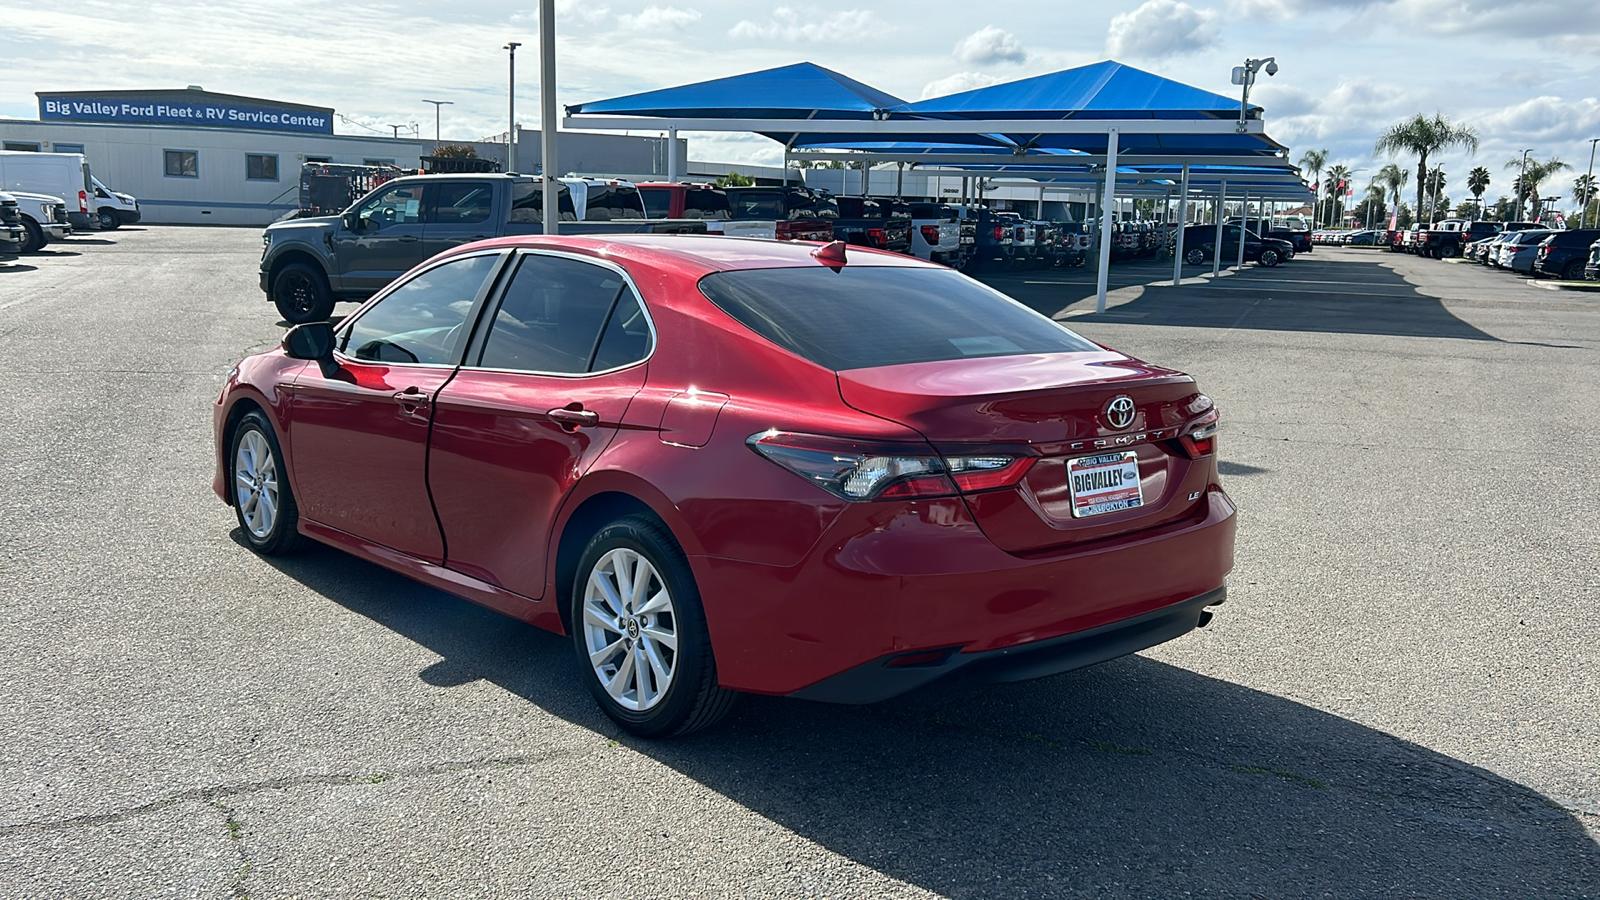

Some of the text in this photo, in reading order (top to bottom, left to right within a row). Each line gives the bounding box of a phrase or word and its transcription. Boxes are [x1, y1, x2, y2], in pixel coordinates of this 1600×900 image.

[45, 101, 325, 127] Big Valley Ford Fleet & RV Service Center
[1070, 431, 1163, 449] CAMRY
[1085, 454, 1121, 466] BIG VALLEY
[1073, 468, 1123, 493] BIGVALLEY
[1187, 491, 1200, 500] LE
